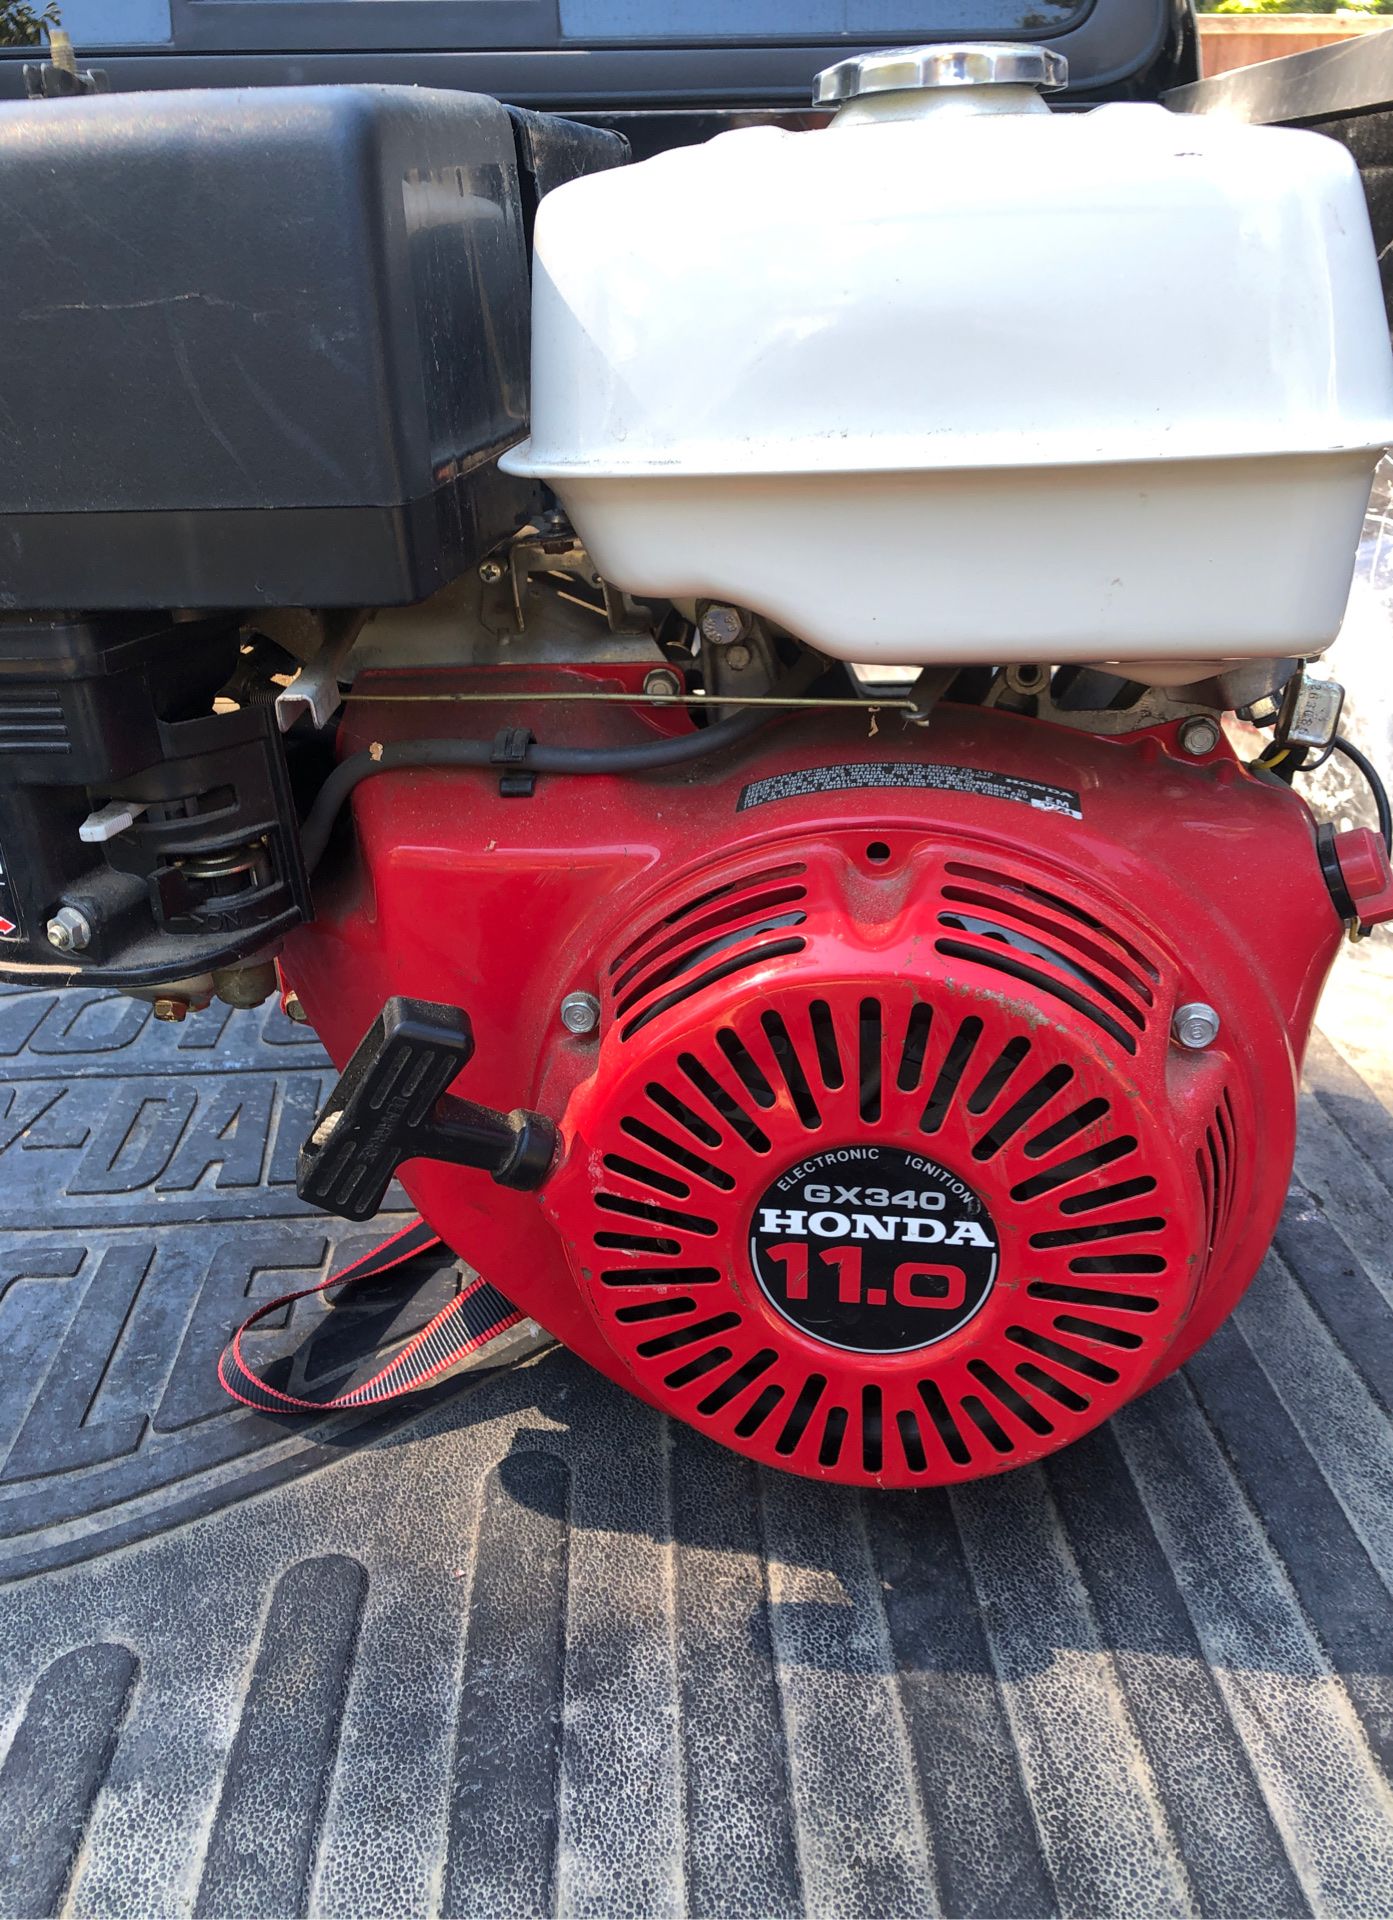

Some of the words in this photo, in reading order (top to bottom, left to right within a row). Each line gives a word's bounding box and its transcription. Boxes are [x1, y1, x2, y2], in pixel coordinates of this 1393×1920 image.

[1004, 778, 1074, 799] HONDA
[1044, 795, 1070, 808] EM
[777, 1148, 880, 1192] ELECTRONIC
[905, 1154, 974, 1204] IGNITION
[804, 1184, 946, 1211] GX340
[759, 1208, 995, 1247] HONDA
[765, 1242, 967, 1310] 11.0
